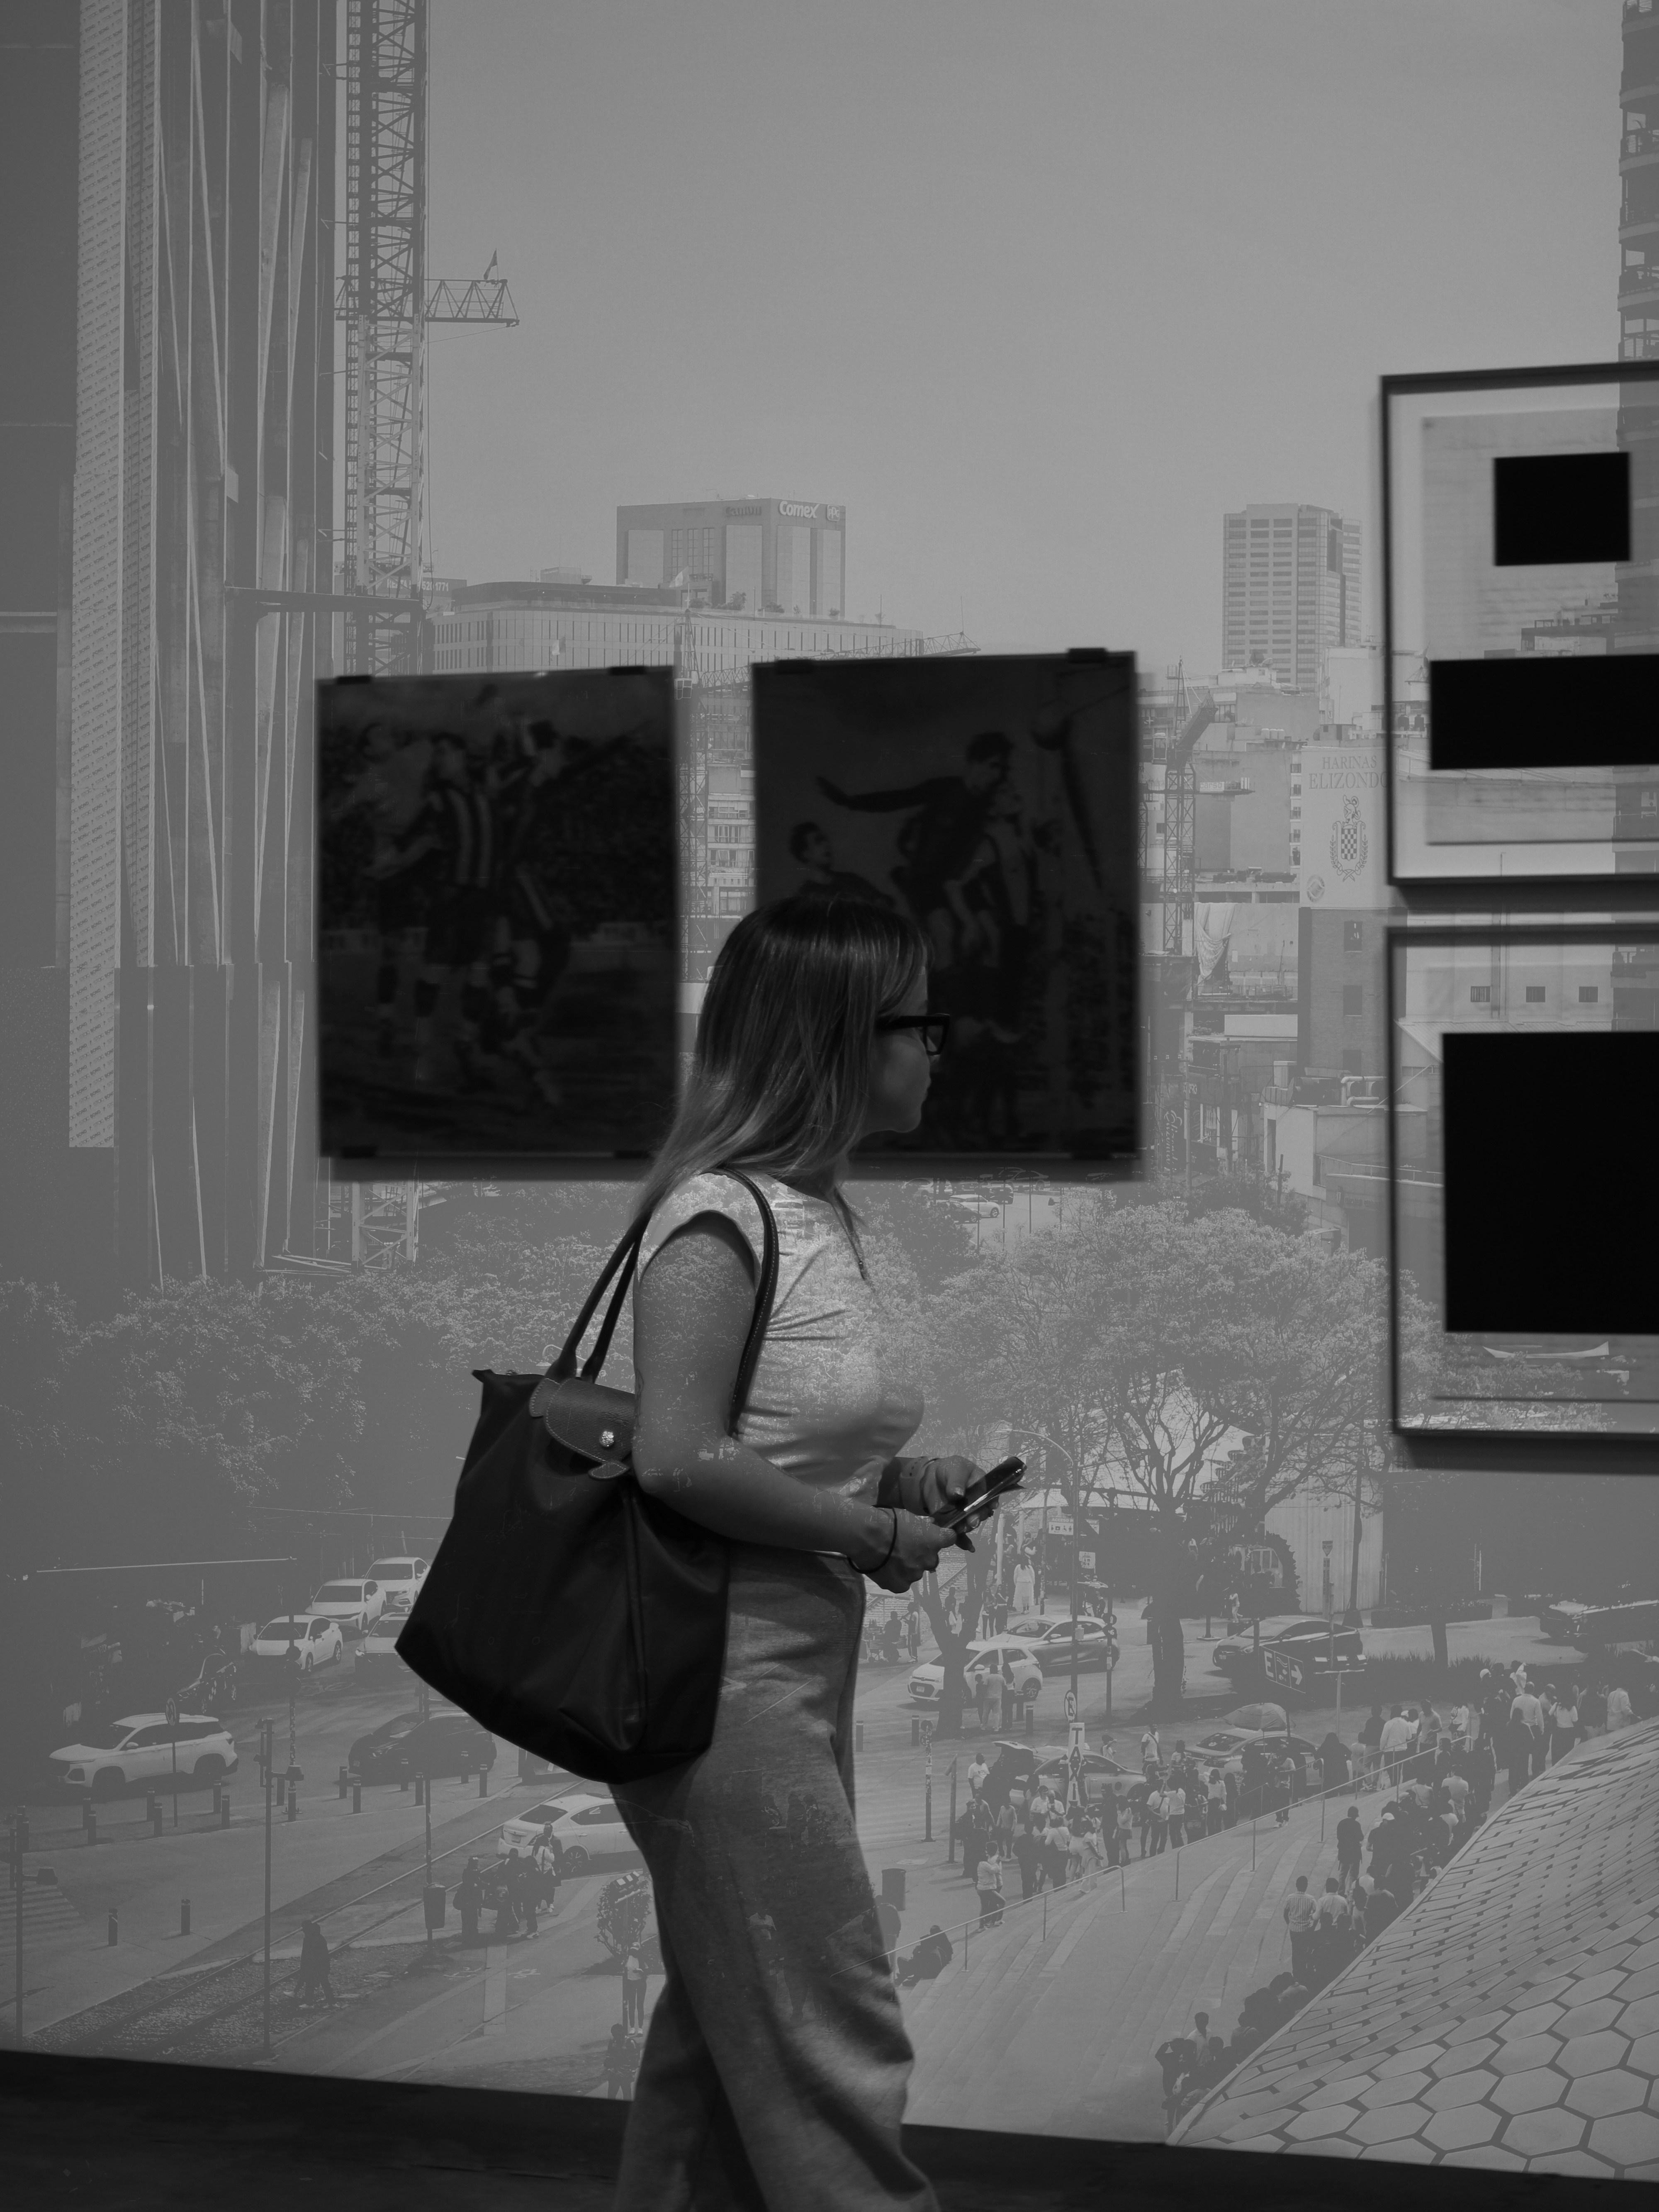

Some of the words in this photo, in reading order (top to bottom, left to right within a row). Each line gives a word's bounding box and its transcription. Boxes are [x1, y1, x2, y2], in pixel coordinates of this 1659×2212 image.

[779, 501, 820, 518] Comex
[829, 507, 840, 518] PPG
[435, 582, 449, 591] 1771
[1322, 755, 1377, 769] HARINAS
[1309, 771, 1387, 789] ELIZONDO
[1264, 1651, 1274, 1678] E
[1068, 1696, 1074, 1717] E
[1069, 1728, 1083, 1800] TAXI
